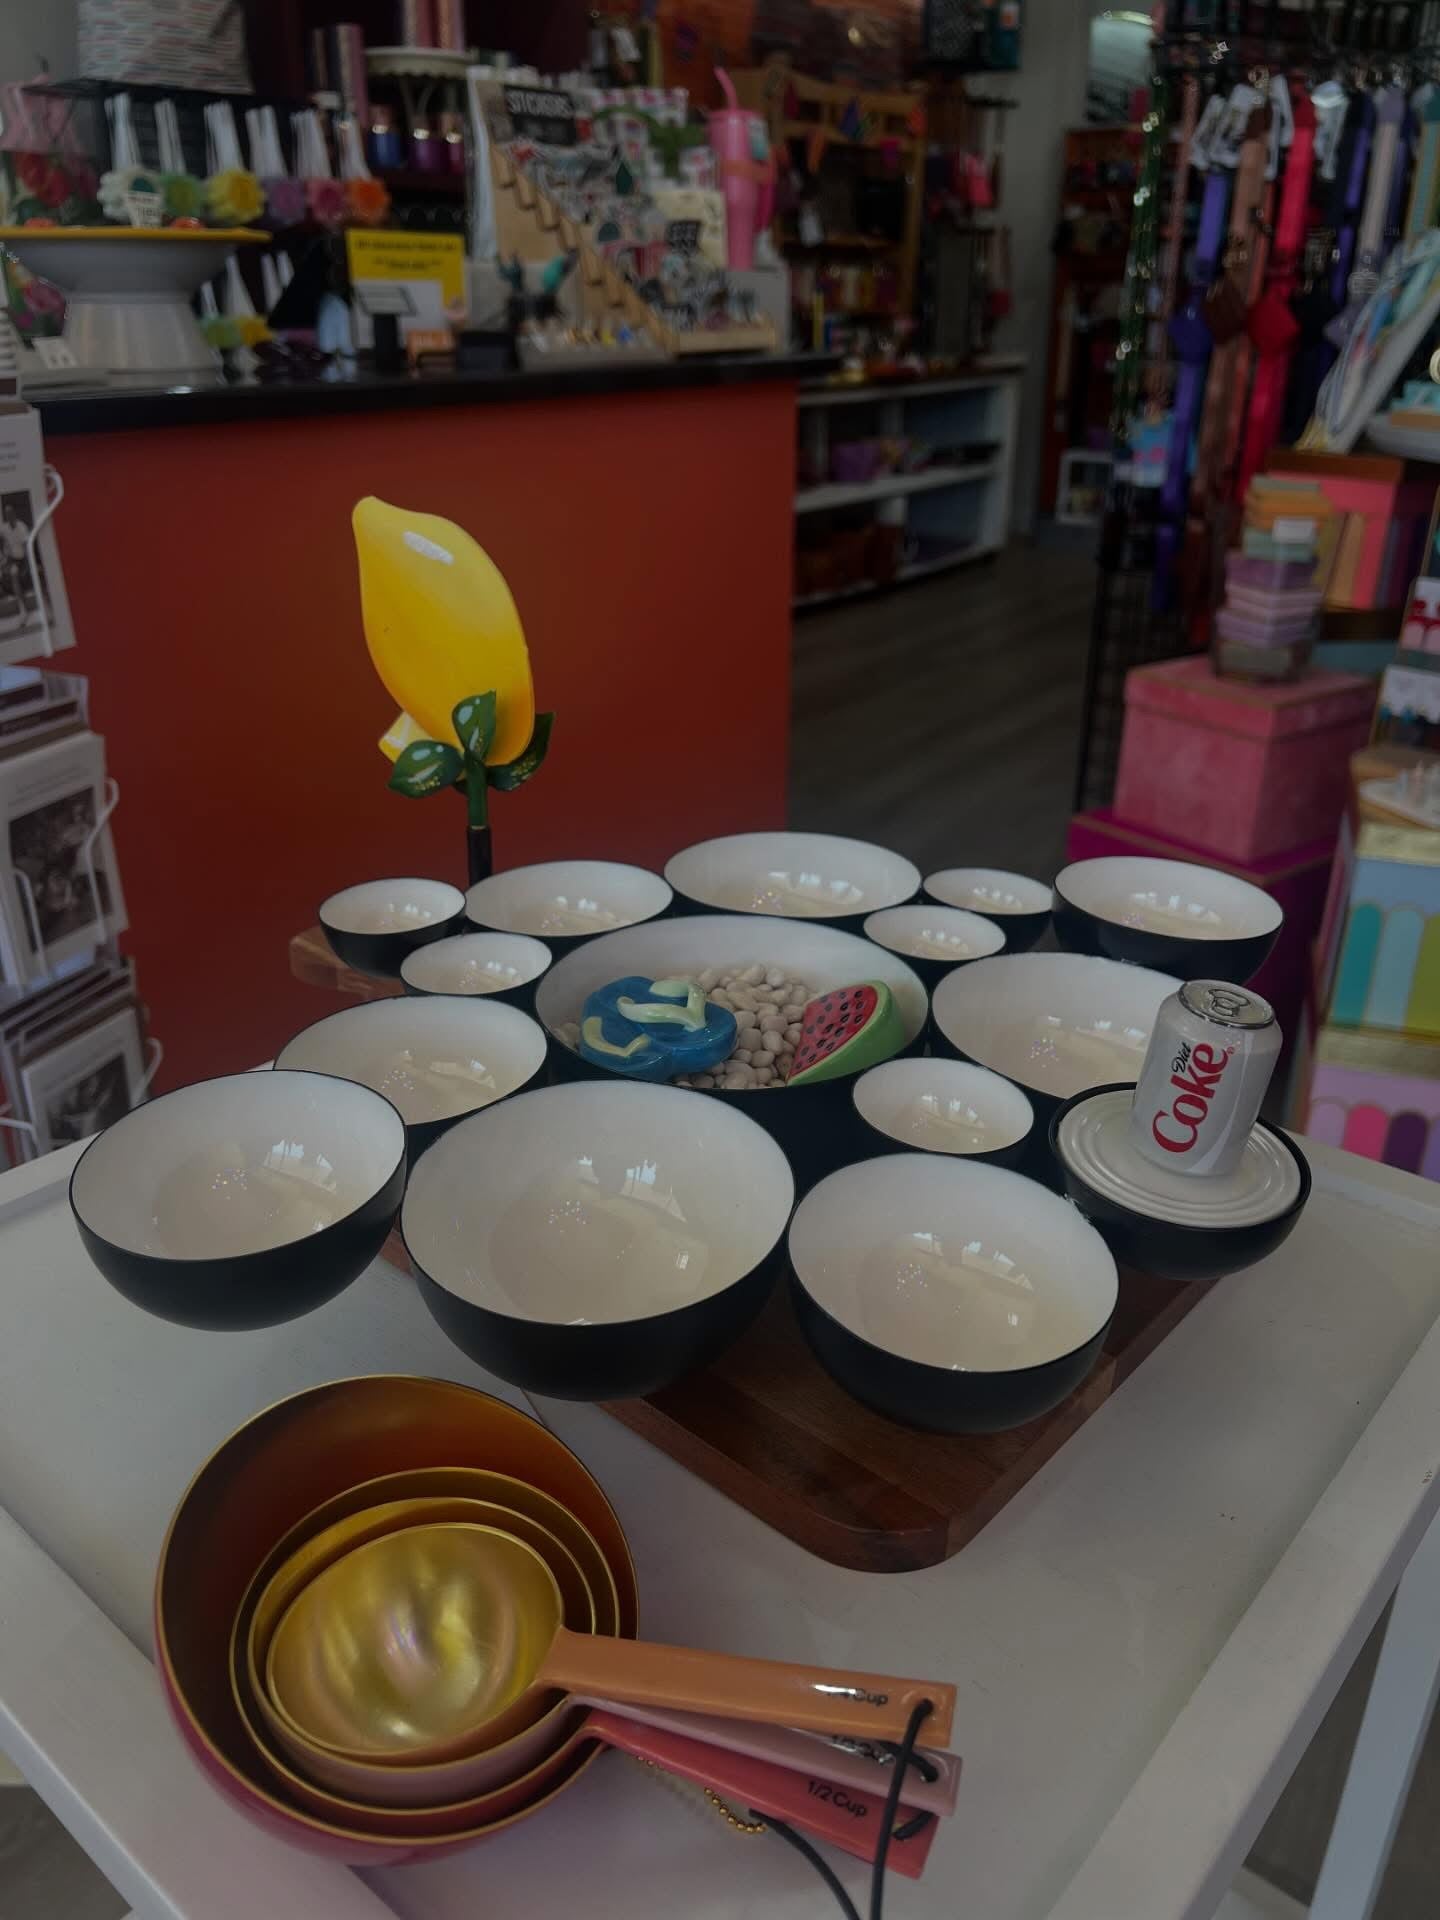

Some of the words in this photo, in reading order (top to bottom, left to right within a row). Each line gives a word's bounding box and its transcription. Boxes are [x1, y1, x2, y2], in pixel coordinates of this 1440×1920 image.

[1171, 1042, 1191, 1073] Diet
[1152, 1043, 1229, 1153] Coke
[808, 1781, 833, 1800] 1/2
[832, 1792, 868, 1817] Cup
